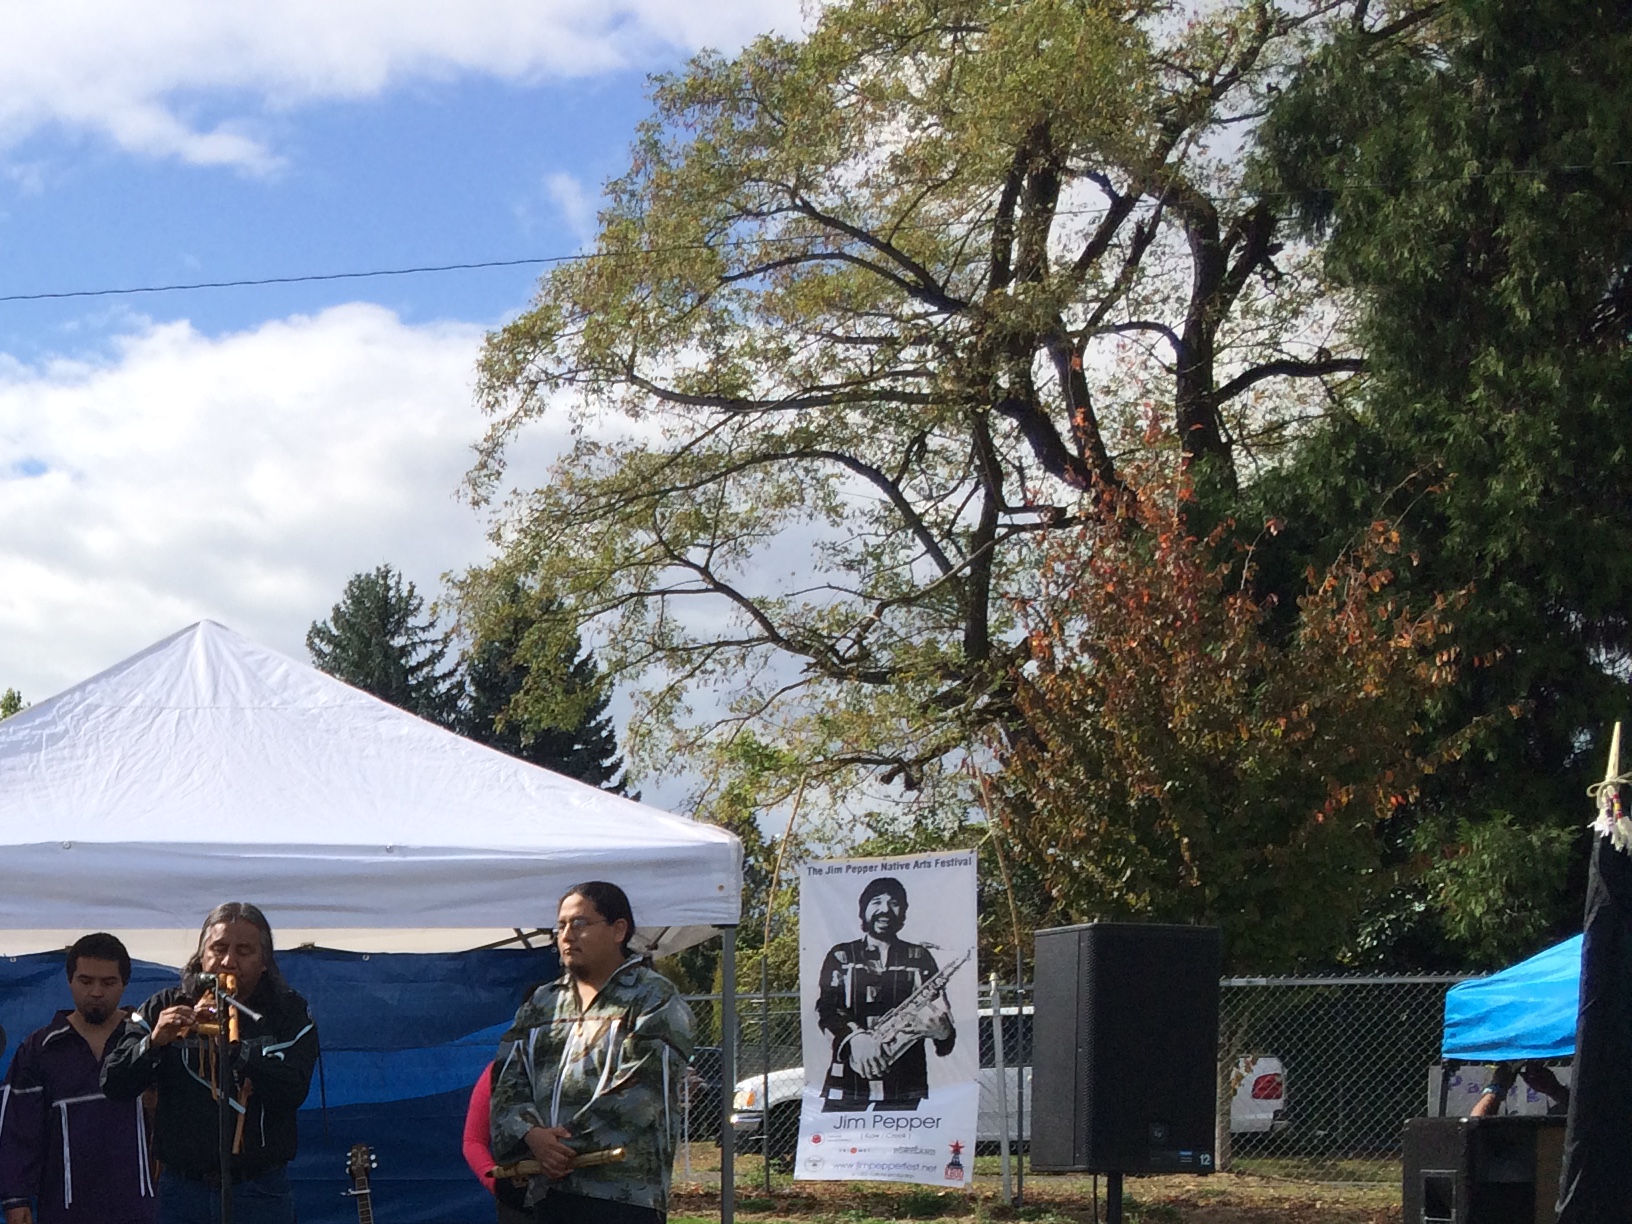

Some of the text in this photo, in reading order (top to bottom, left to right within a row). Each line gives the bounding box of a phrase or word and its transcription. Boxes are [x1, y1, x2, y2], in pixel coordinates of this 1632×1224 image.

[807, 857, 972, 876] The Jim Pepper Native Arts Festival
[833, 1114, 942, 1132] Jim Pepper
[1199, 1154, 1211, 1166] 12
